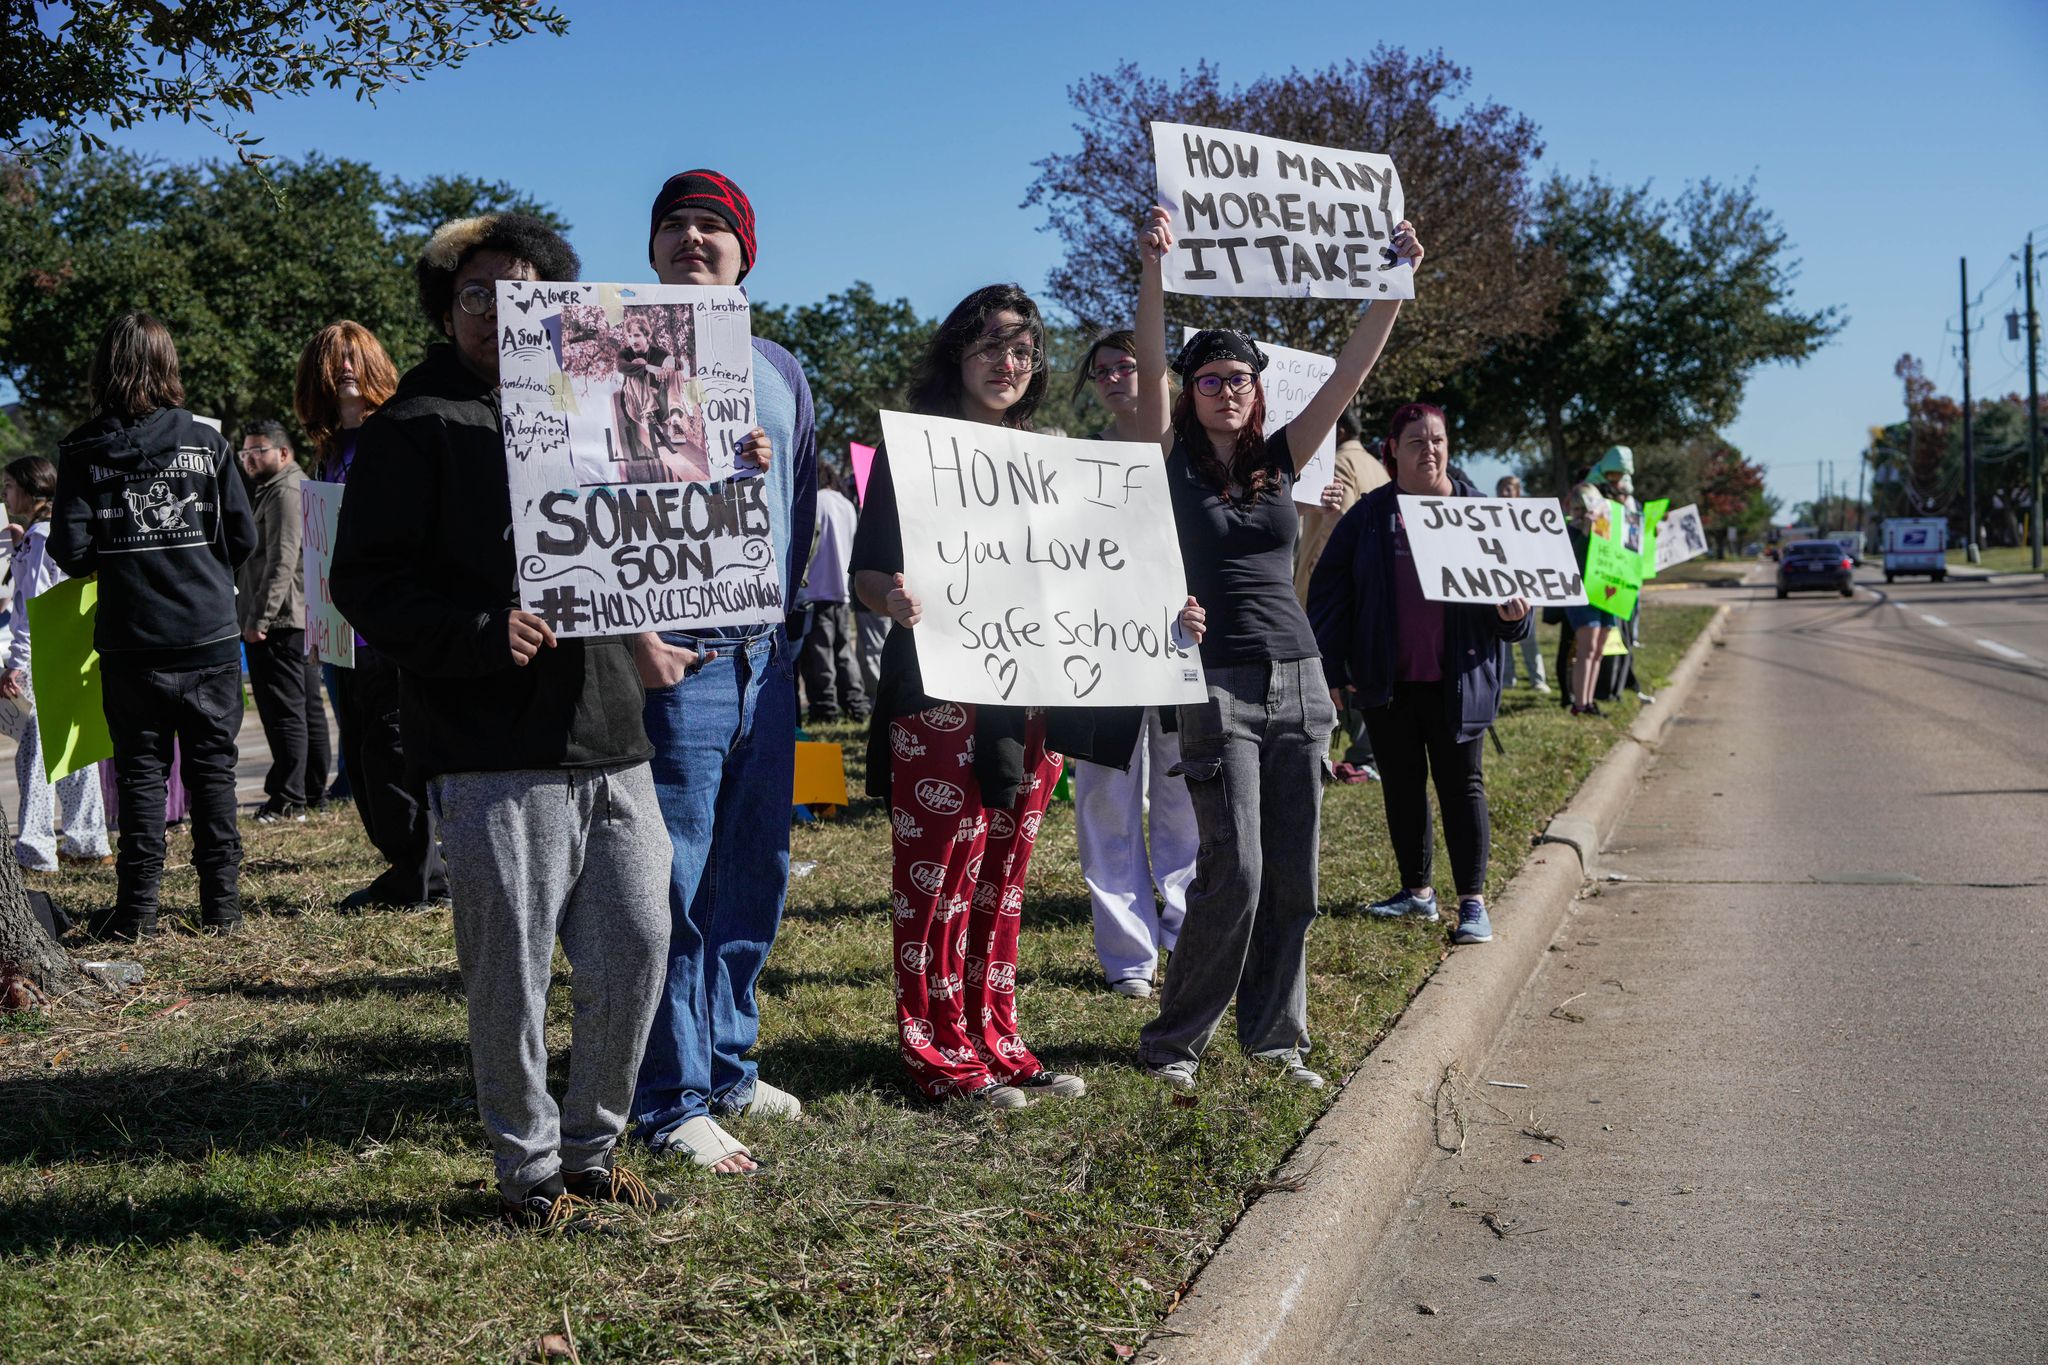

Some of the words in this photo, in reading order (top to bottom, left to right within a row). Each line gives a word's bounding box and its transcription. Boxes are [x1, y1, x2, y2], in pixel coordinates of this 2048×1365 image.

[1183, 133, 1258, 179] HOW
[1277, 150, 1392, 211] MANY
[1183, 190, 1305, 232] MORE
[1178, 236, 1248, 284] IT
[1254, 235, 1398, 293] TAKE?
[531, 288, 548, 309] A
[696, 302, 707, 312] a
[711, 298, 749, 313] brother
[501, 325, 517, 351] A
[698, 365, 709, 376] a
[711, 361, 749, 384] friend
[500, 376, 556, 396] ambitious
[707, 397, 750, 424] ONLY
[503, 417, 515, 438] A
[923, 429, 1059, 508] HONK
[96, 508, 124, 519] WORLD
[194, 502, 214, 513] TOUR
[1477, 537, 1508, 565] 4
[611, 542, 715, 591] SON
[1441, 566, 1582, 601] ANDREW
[958, 606, 1045, 651] Safe
[919, 784, 962, 809] Pepper
[934, 783, 956, 799] Dr
